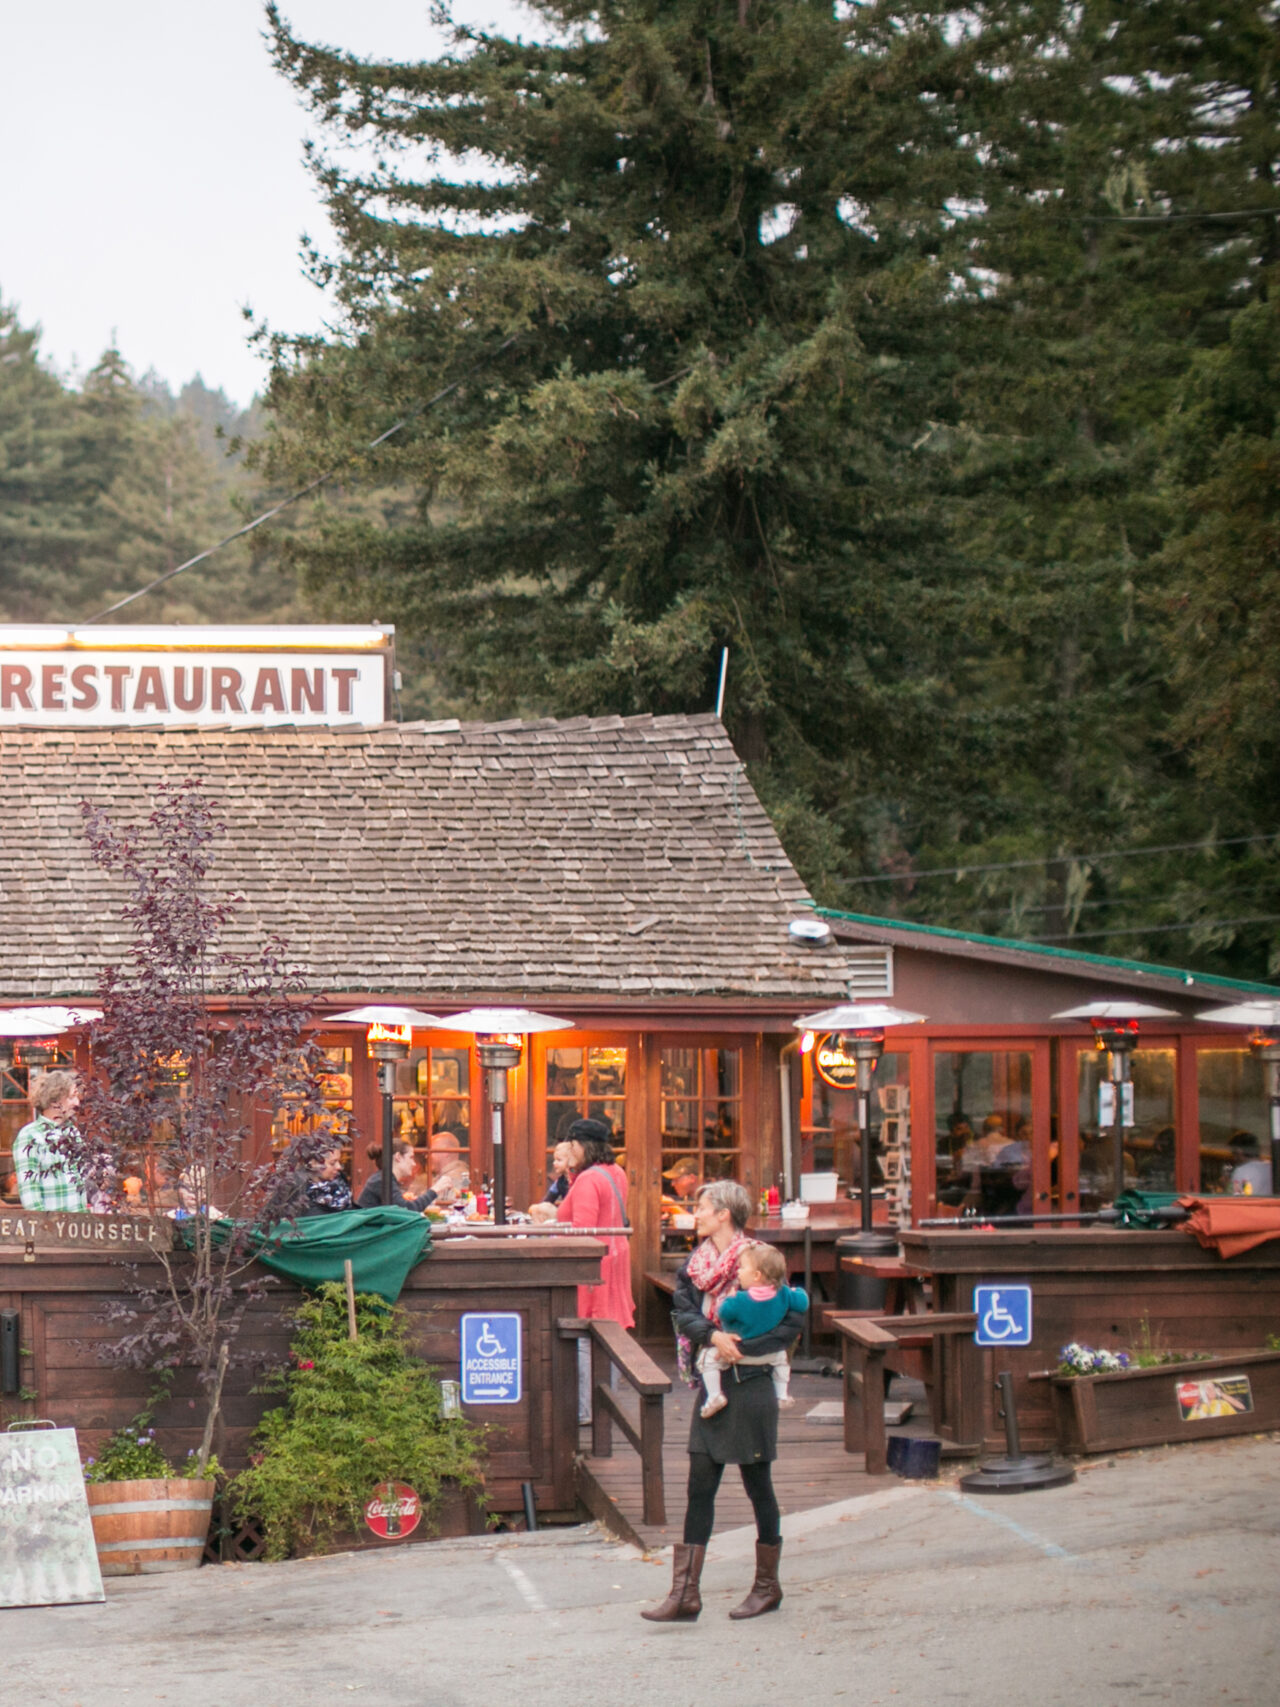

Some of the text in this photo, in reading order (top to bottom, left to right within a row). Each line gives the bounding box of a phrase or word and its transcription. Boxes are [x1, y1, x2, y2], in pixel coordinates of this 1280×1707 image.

[0, 664, 360, 714] RESTAURANT
[56, 1221, 158, 1242] YOURSELF
[466, 1358, 517, 1370] ACCESSIBLE
[469, 1372, 514, 1385] ENTRANCE
[10, 1447, 58, 1471] NO
